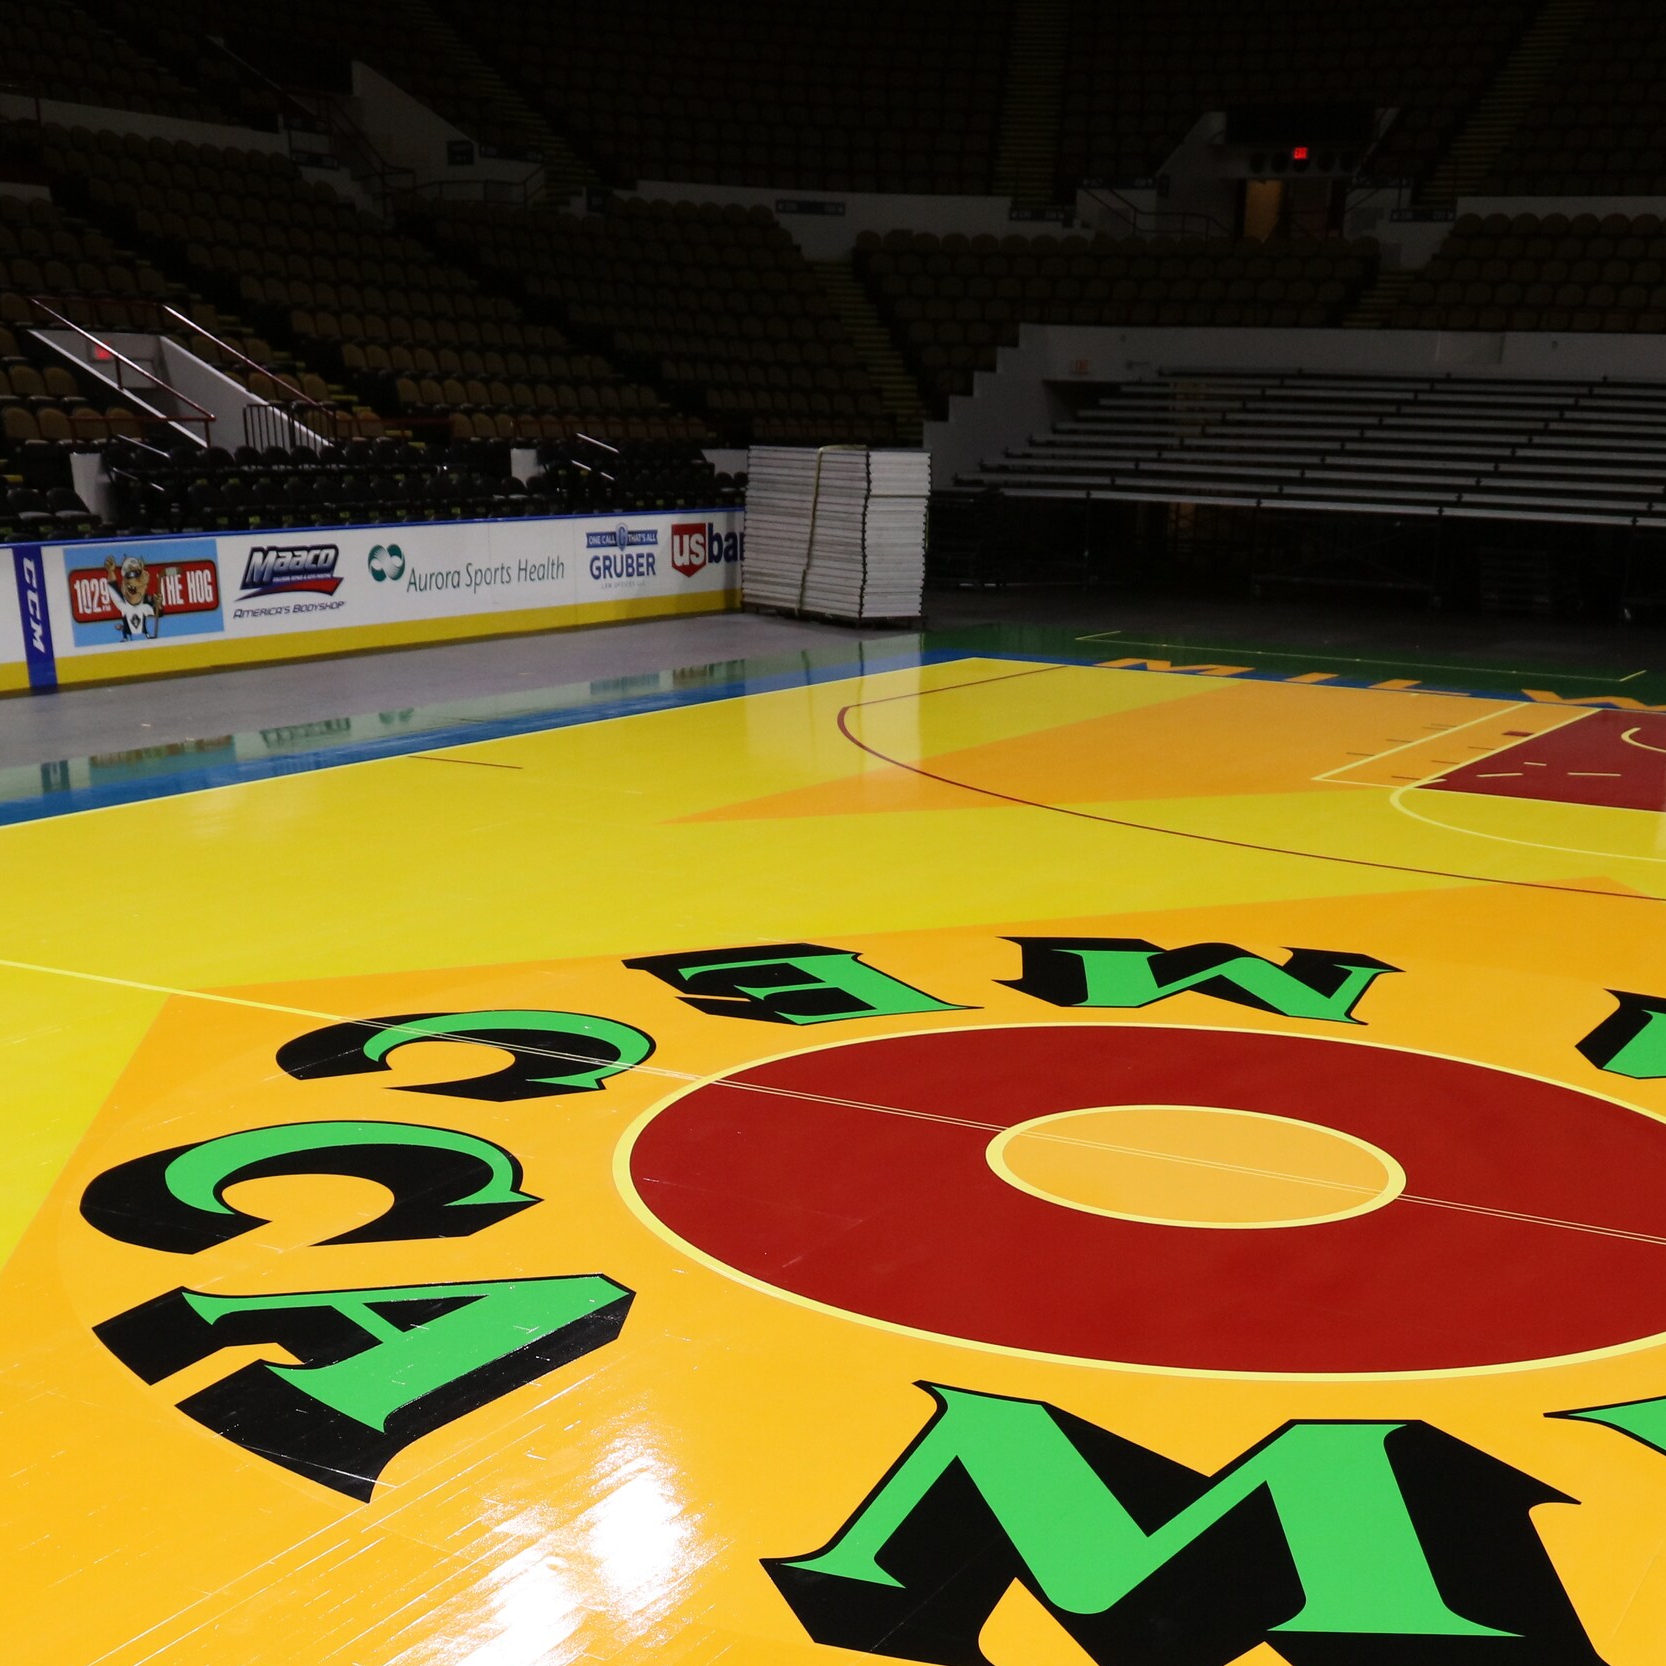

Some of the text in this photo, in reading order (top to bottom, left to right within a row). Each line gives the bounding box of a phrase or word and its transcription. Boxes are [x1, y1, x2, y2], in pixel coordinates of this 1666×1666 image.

[588, 535, 616, 545] ONE CALL
[628, 532, 656, 543] THAT'S ALL
[243, 546, 338, 585] Maaco
[406, 555, 565, 594] Aurora Sports Health
[589, 552, 657, 580] GRUBER
[186, 569, 214, 603] HOG
[23, 557, 46, 654] CCM
[233, 600, 345, 619] AMERICA'S BODYSHOP
